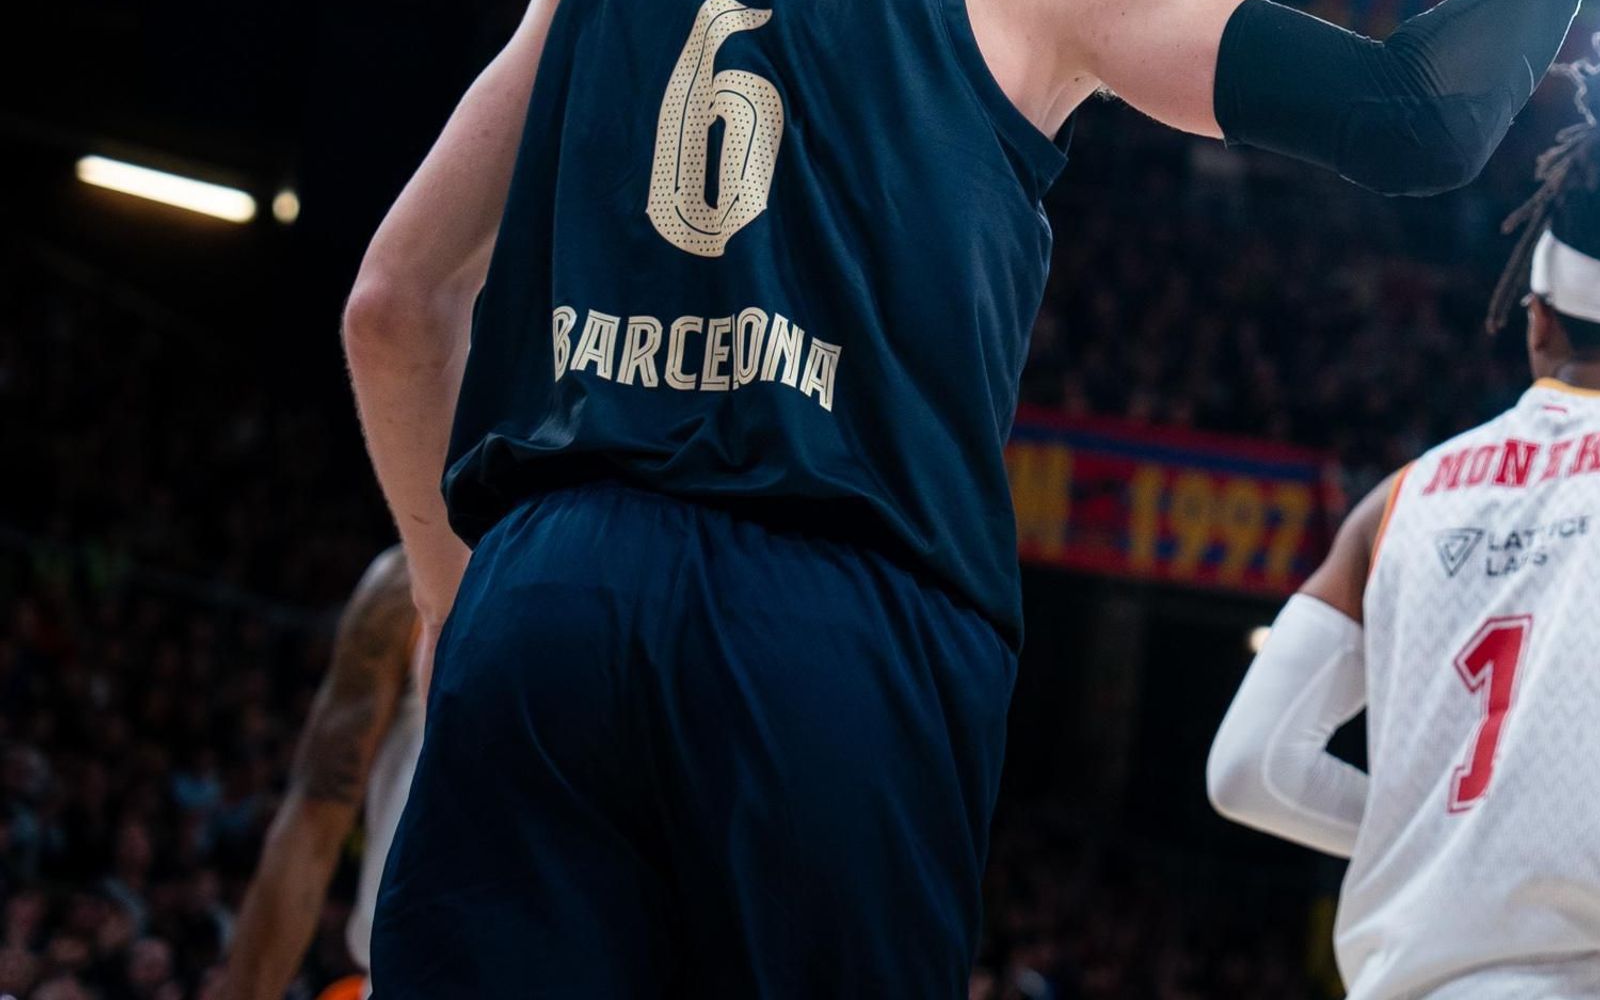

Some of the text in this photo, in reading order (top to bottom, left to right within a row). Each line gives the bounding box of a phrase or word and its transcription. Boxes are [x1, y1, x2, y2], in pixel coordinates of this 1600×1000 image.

[552, 305, 842, 412] BARCEONA
[1128, 462, 1310, 585] 1997
[1486, 514, 1591, 553] LATCE
[1486, 551, 1548, 578] LAS
[1447, 614, 1534, 815] 1
